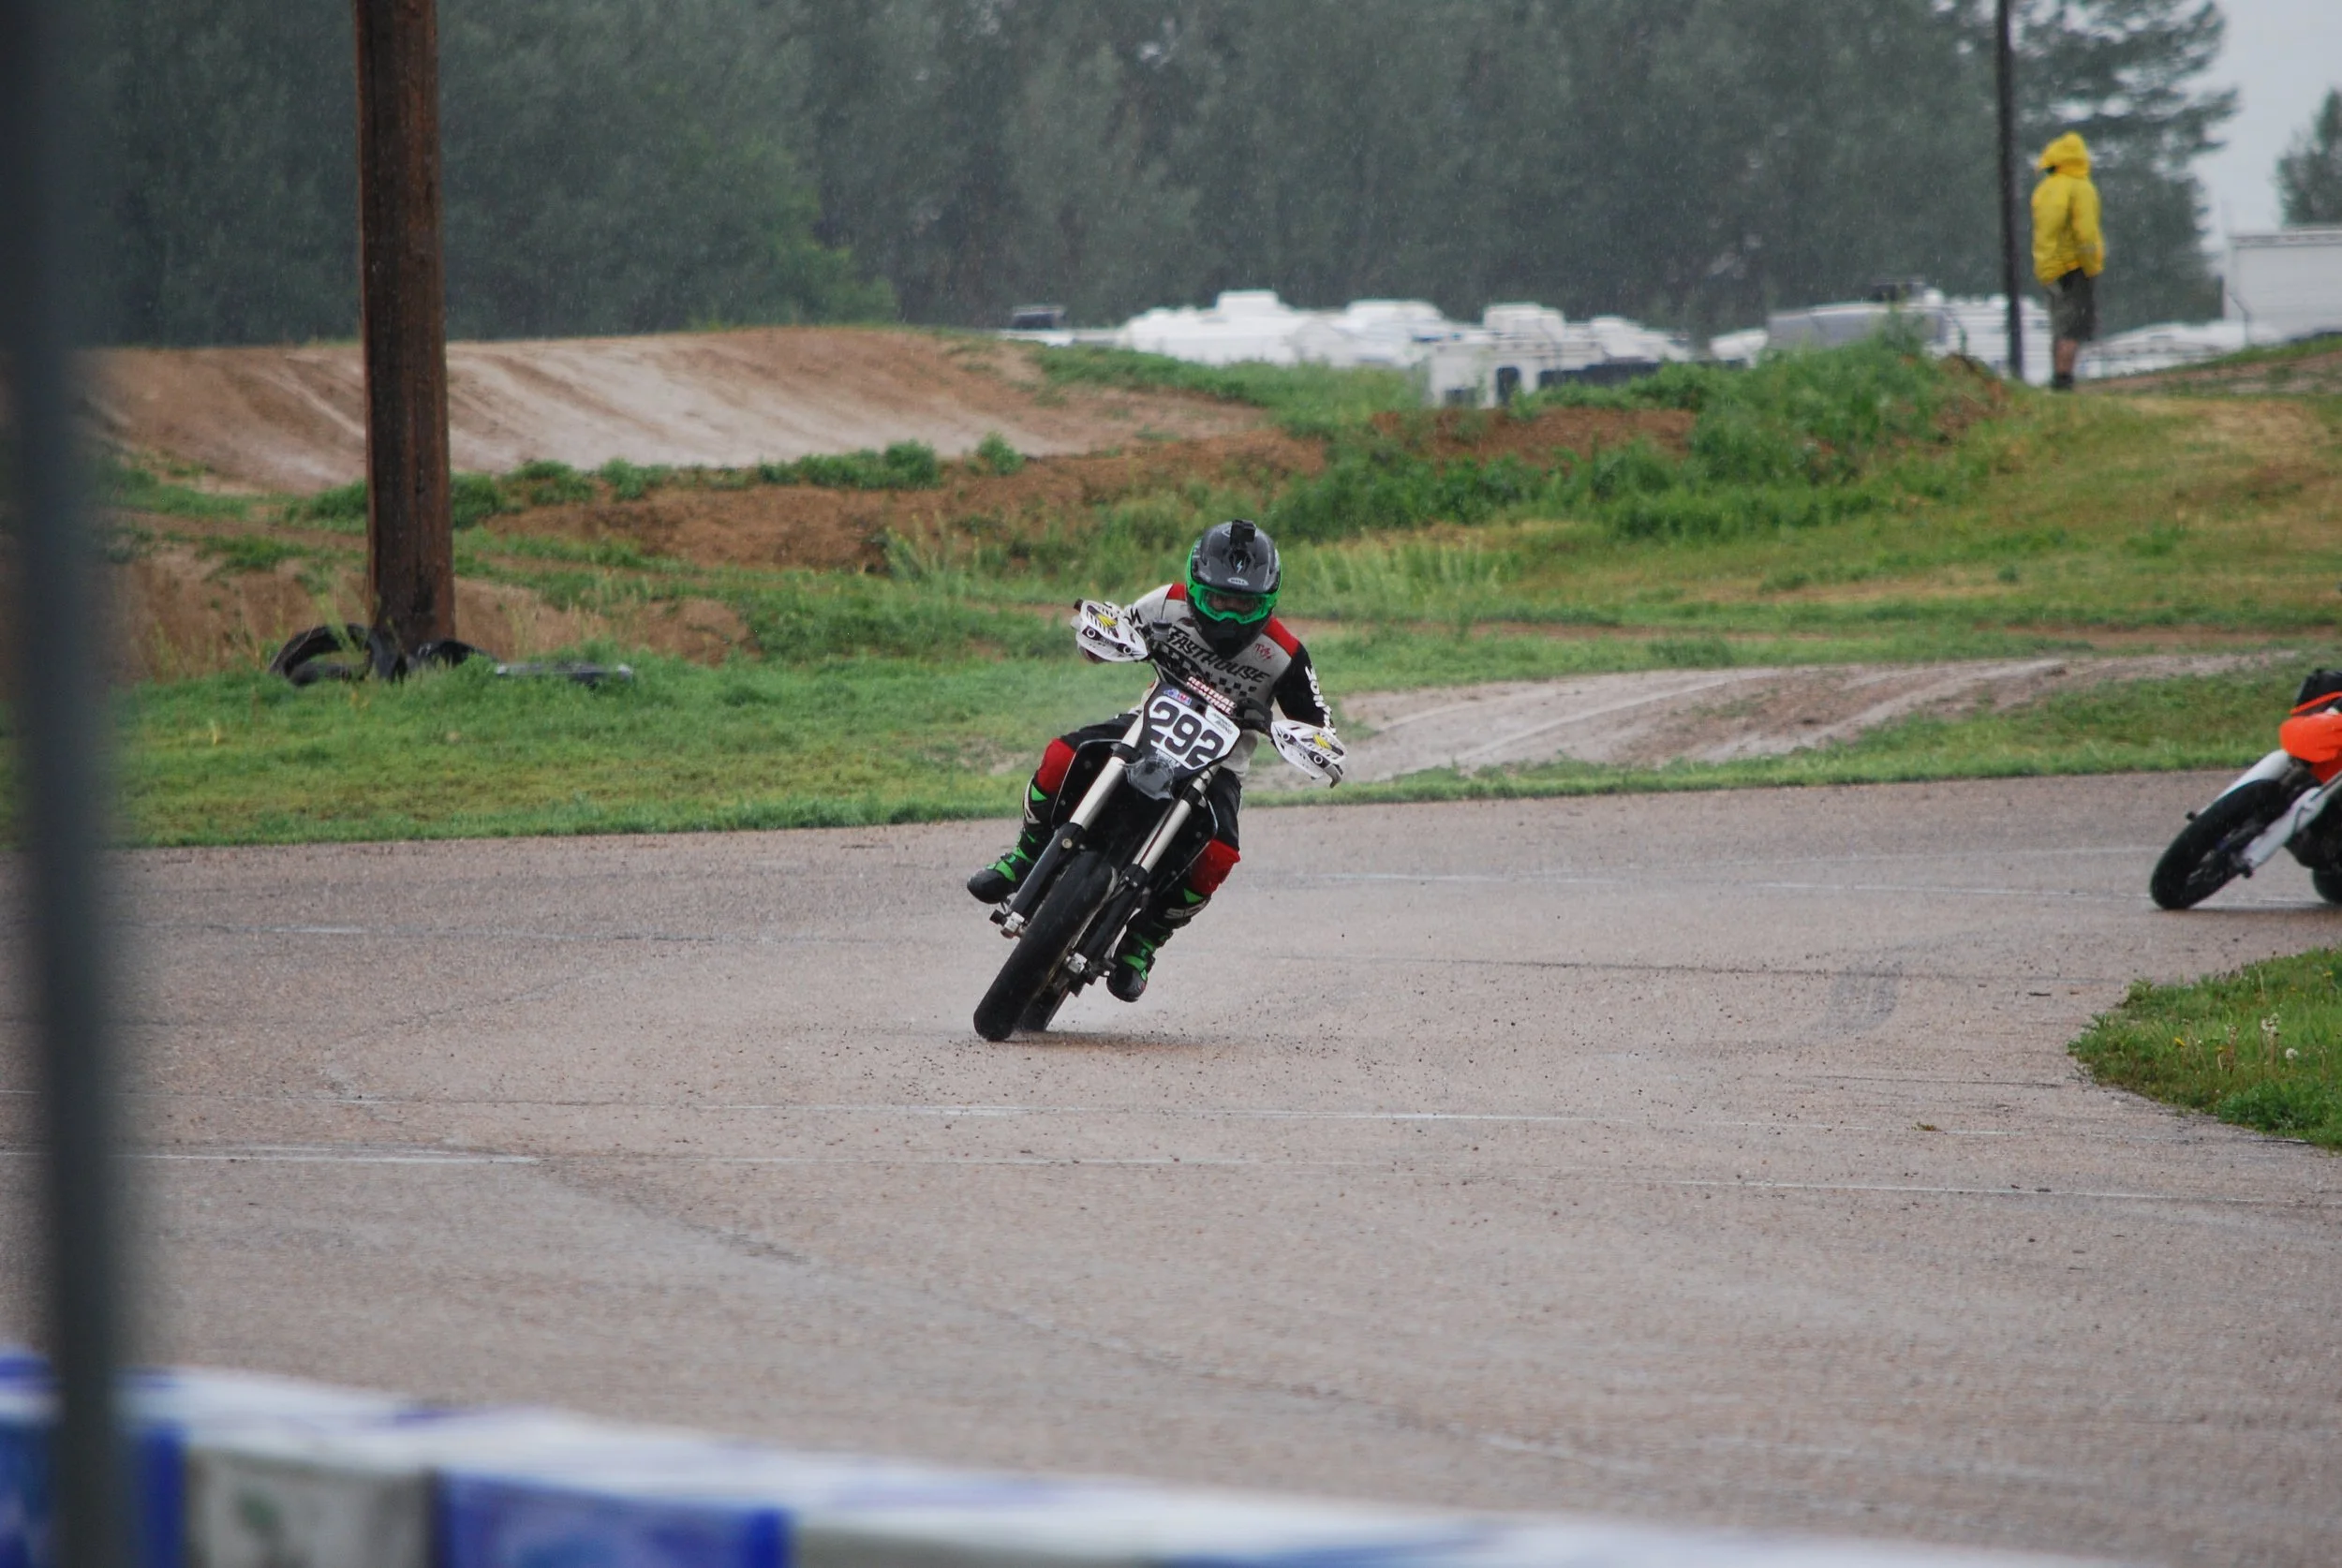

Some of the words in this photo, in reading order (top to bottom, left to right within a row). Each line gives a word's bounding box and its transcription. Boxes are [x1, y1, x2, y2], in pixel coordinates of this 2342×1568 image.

[1166, 626, 1270, 683] FASTHOUSE
[1187, 676, 1237, 709] RENTHAL
[1149, 701, 1224, 768] 292
